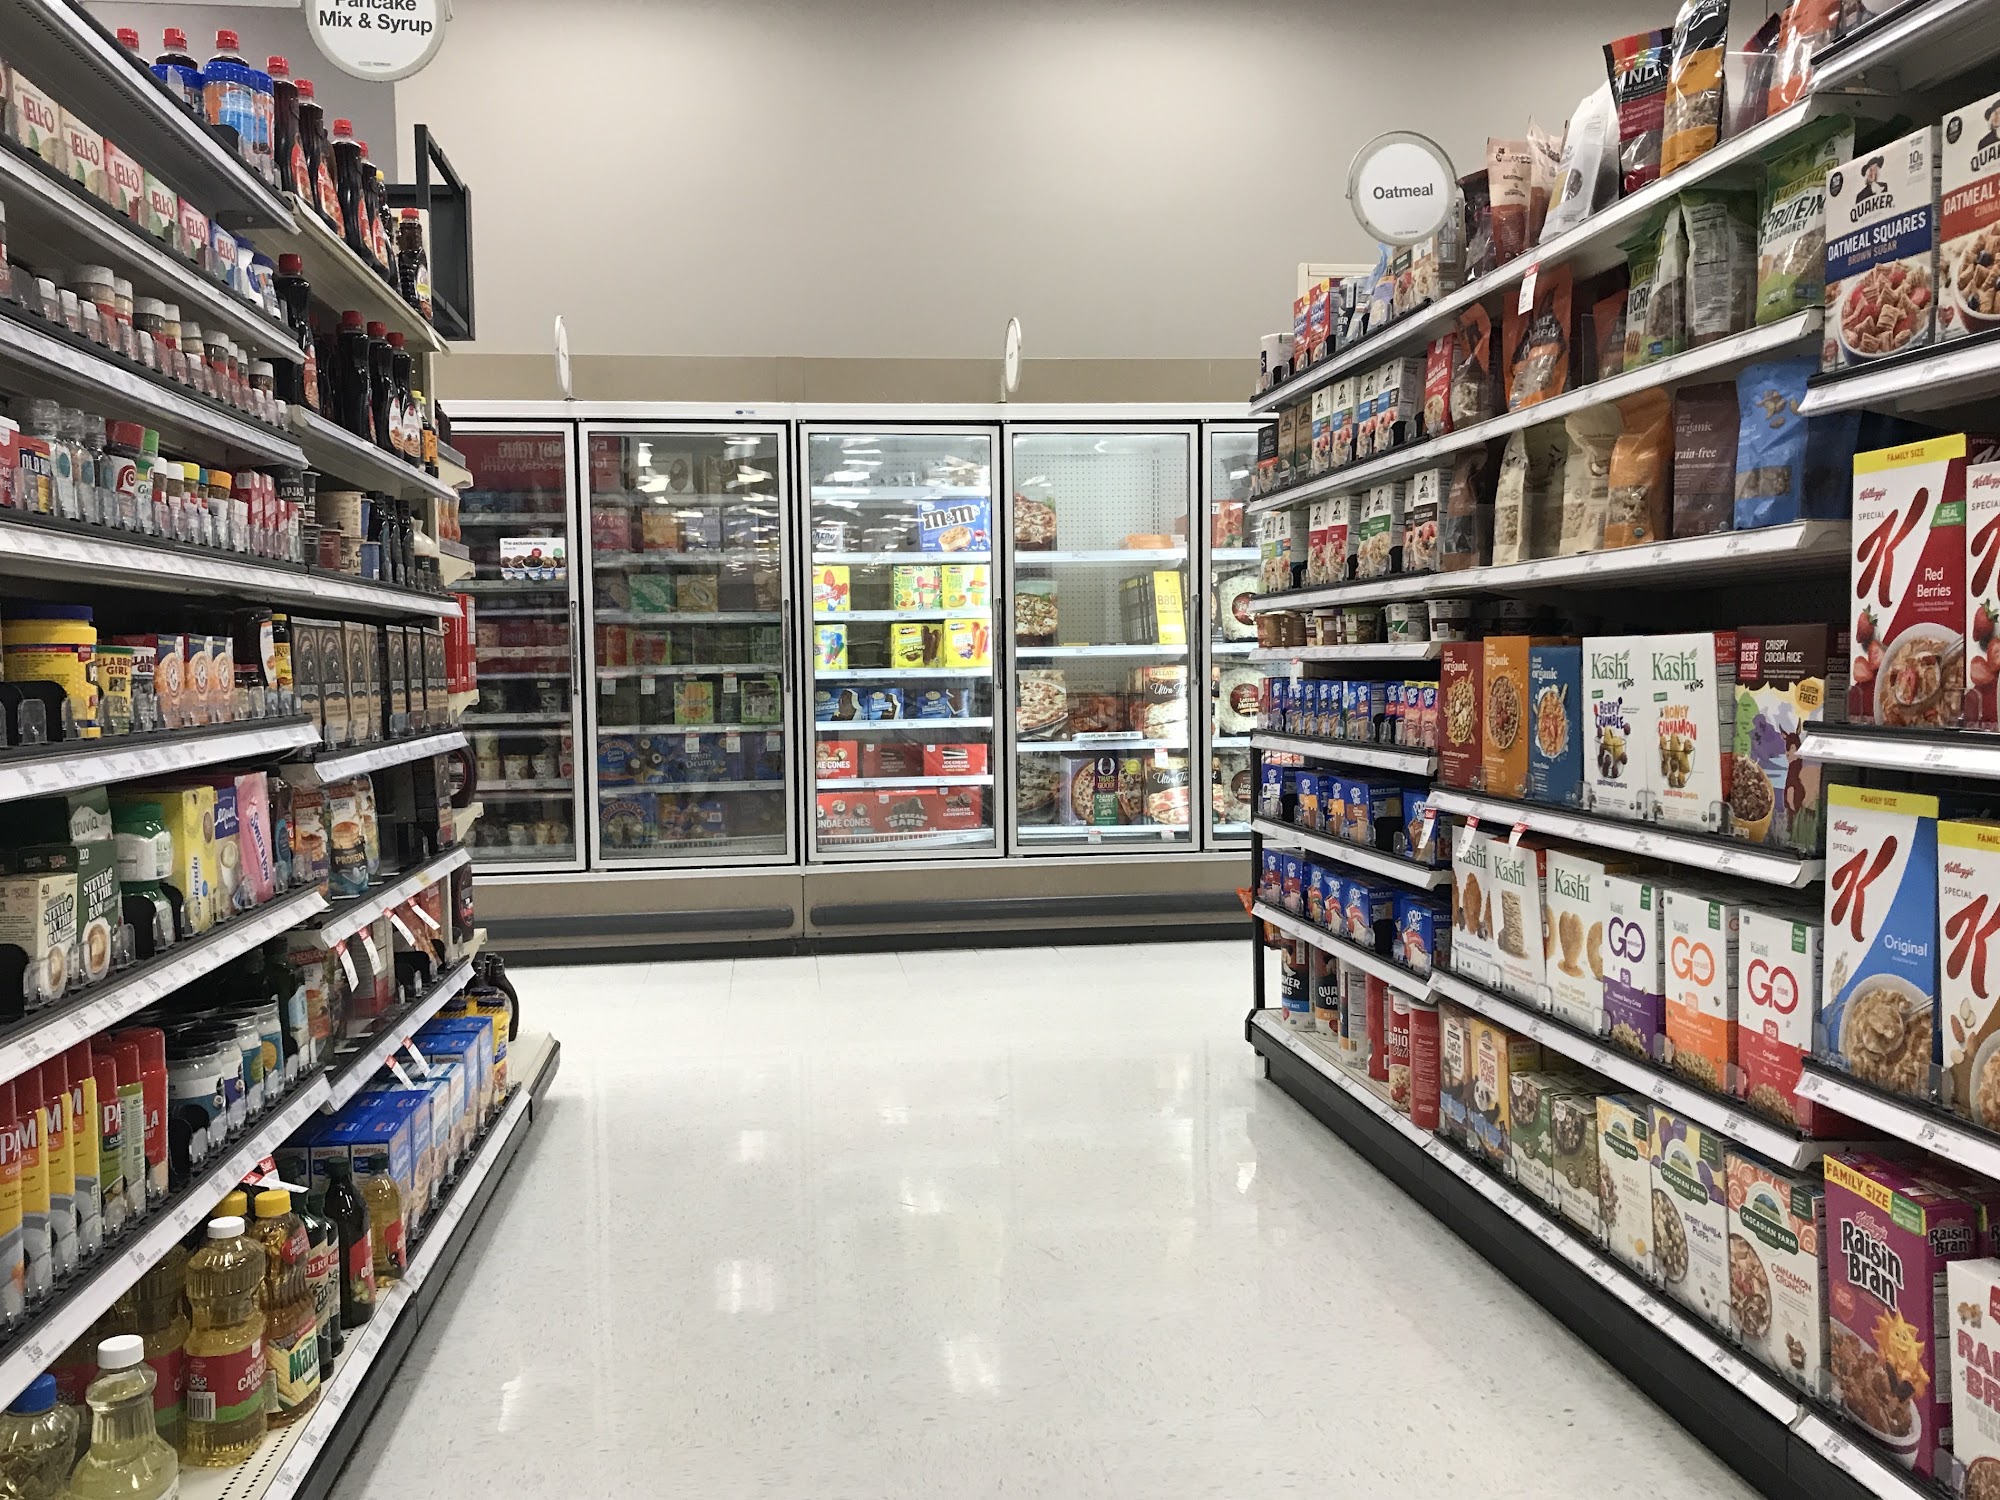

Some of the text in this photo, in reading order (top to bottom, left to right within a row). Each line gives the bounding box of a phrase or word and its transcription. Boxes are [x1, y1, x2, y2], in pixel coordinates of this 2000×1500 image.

[319, 10, 433, 36] Mix & Syrup
[1970, 148, 2000, 171] QUA
[1373, 183, 1433, 200] Oatmeal
[1850, 194, 1894, 222] QUAKER
[1943, 185, 1994, 216] OATMEAL
[1828, 211, 1927, 262] OATMEAL SQUARES
[1886, 447, 1925, 462] FAMILY SIZE
[1971, 499, 2000, 511] SPECIA
[1858, 511, 1886, 521] SPECIAL
[1857, 487, 1929, 608] K
[1925, 567, 1944, 581] Red
[1917, 583, 1951, 598] Berries
[1765, 640, 1788, 650] CRISPY
[1486, 654, 1509, 670] organic
[1741, 651, 1758, 662] BEST
[1764, 652, 1802, 663] COCOA RICE
[106, 666, 128, 676] GIRL
[1444, 660, 1468, 676] organic
[1591, 653, 1629, 680] Kashi
[1652, 652, 1697, 682] Kashi
[1532, 669, 1558, 684] organic
[1800, 684, 1819, 694] GLUTEN
[1799, 692, 1818, 705] FREE!
[1664, 705, 1689, 719] HONEY
[686, 759, 717, 769] Drums
[827, 761, 850, 769] CONES
[1860, 794, 1897, 807] FAMILY SIZE
[817, 818, 871, 829] UNDAE CONES
[1977, 833, 2000, 844] FAMIL
[1832, 842, 1857, 854] SPECIAL
[335, 852, 365, 865] PROTEIN
[1494, 856, 1526, 887] Kashi
[1554, 868, 1590, 903] Kashi
[1831, 835, 1898, 943] K
[1944, 886, 1973, 900] SPECIAL
[1608, 916, 1646, 963] GO
[1884, 934, 1928, 958] Original
[1671, 935, 1715, 987] GO
[1282, 976, 1300, 990] KER
[1747, 958, 1799, 1015] GO
[1318, 986, 1338, 997] QUA
[1326, 997, 1338, 1005] OA
[1393, 1027, 1409, 1035] OLD
[104, 1103, 121, 1133] PA
[0, 1129, 22, 1165] PA
[1689, 1184, 1707, 1200] FARM
[1825, 1161, 1864, 1196] FAMILY
[1865, 1183, 1889, 1209] SIZE
[1741, 1211, 1797, 1248] CASCADIAN FARM
[1929, 1227, 1972, 1244] Raisin
[1842, 1220, 1903, 1289] Raisin
[1935, 1240, 1969, 1256] Bran
[1771, 1262, 1812, 1293] CINNAMON
[1776, 1274, 1805, 1297] CRUNCH
[1849, 1253, 1897, 1311] Bran
[1966, 1365, 2000, 1414] BR
